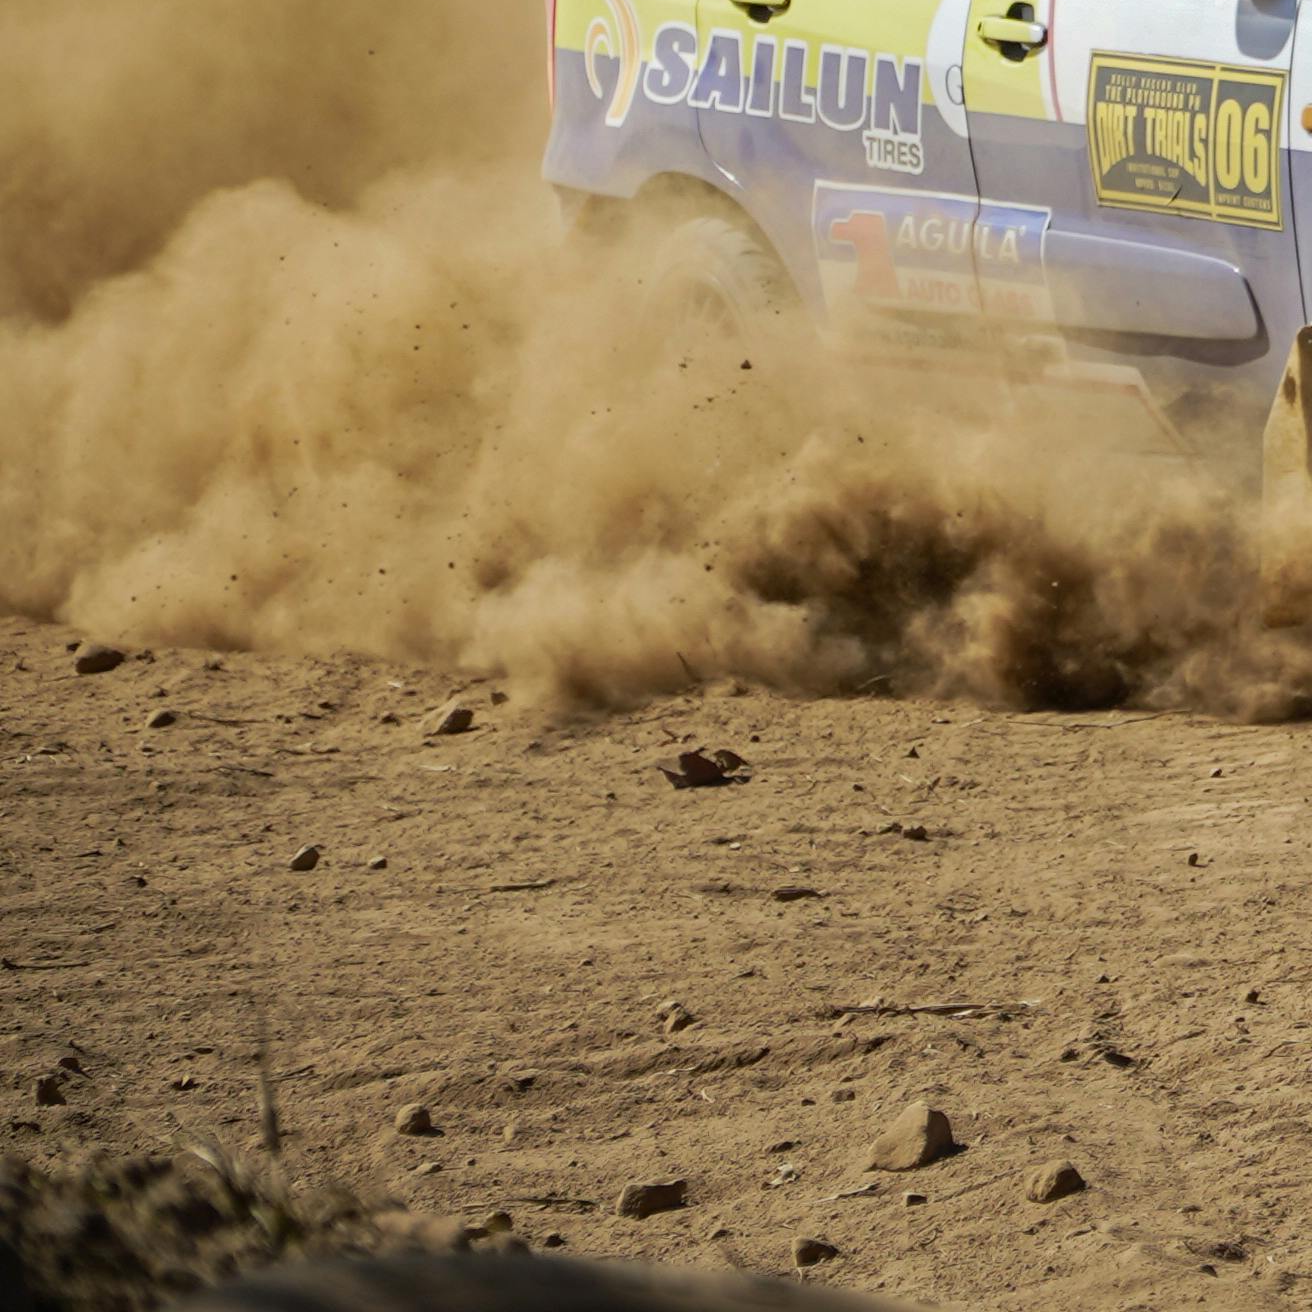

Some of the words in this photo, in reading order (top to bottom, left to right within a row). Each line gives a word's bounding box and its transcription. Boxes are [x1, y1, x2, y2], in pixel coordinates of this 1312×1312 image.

[645, 23, 923, 136] SAILUN
[866, 136, 923, 172] TIRES
[1095, 101, 1138, 177] DIRT
[1143, 104, 1207, 187] TRIALS
[1215, 98, 1271, 194] 06
